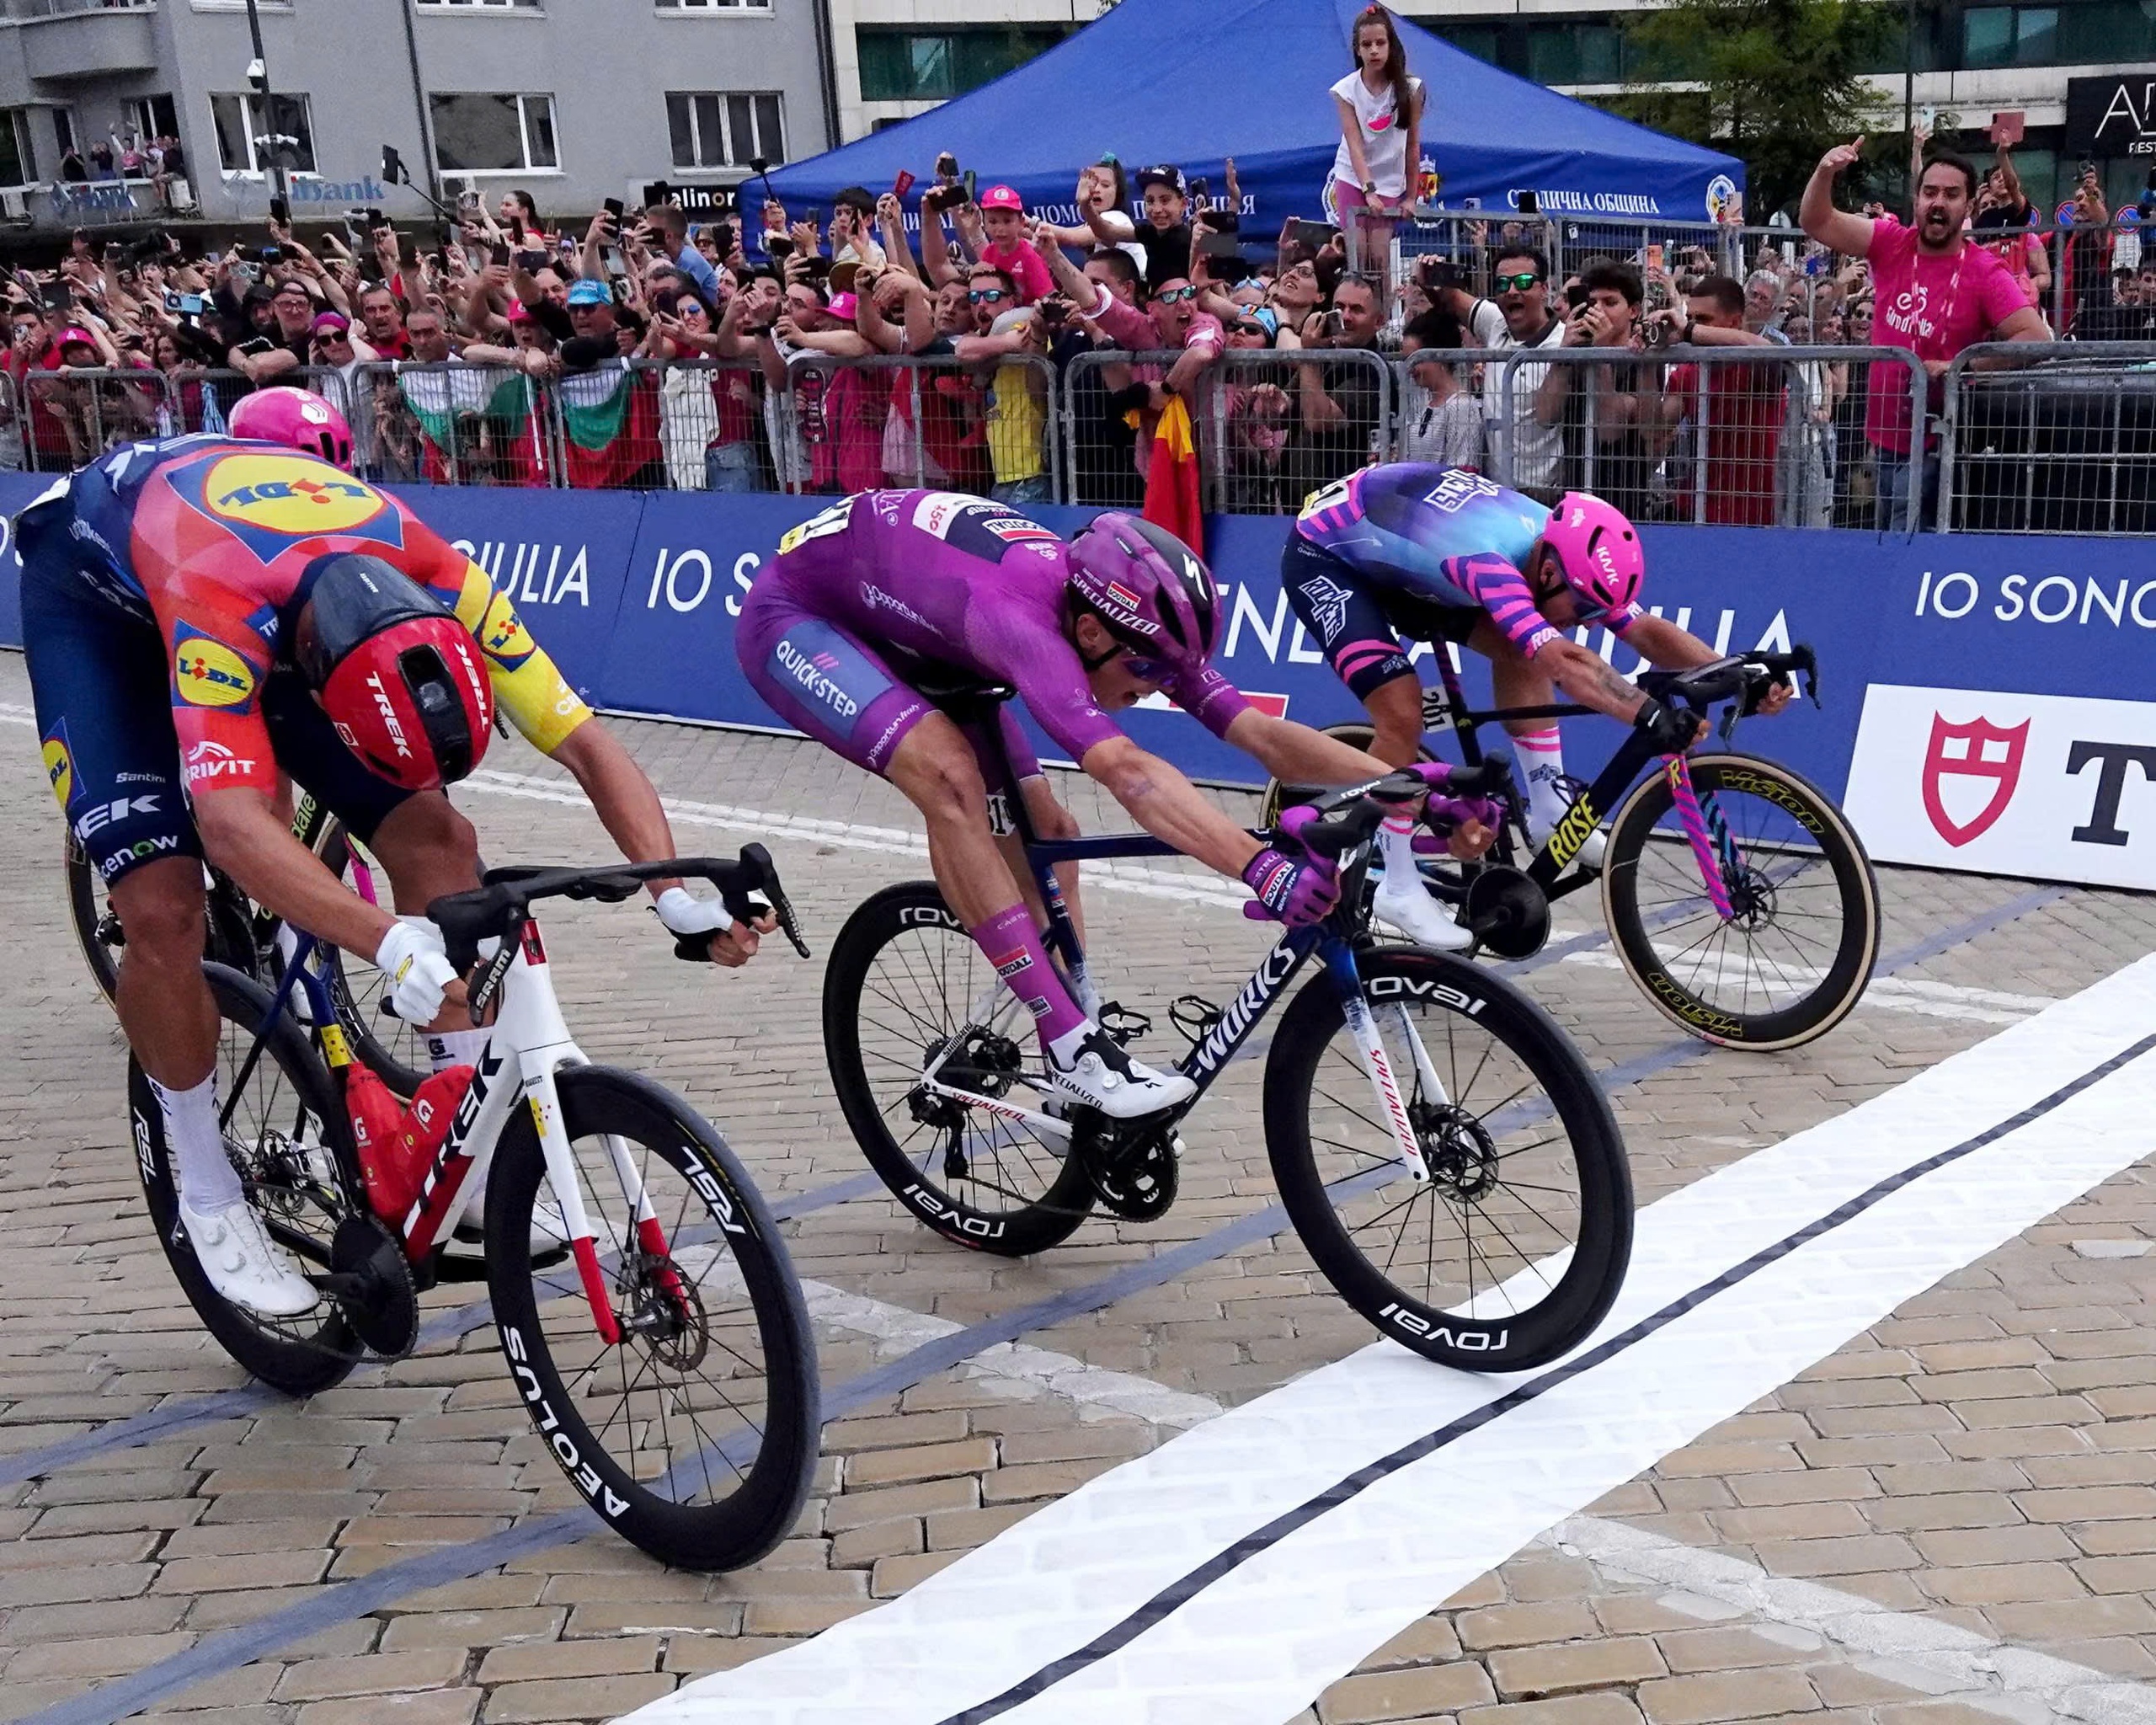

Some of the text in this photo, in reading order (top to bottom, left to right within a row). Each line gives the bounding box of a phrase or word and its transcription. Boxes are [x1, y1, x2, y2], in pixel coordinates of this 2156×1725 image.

[291, 174, 385, 200] ibank
[1507, 189, 1660, 215] СЛИЧНА ОБЩИНА
[648, 548, 712, 614] IO
[1070, 572, 1161, 636] SPECIALIZED
[1108, 588, 1137, 611] SOUDAL
[1915, 571, 1979, 618] IO
[1531, 627, 1564, 651] ROS
[454, 643, 490, 732] TREK
[1422, 692, 1446, 731] 201
[366, 670, 413, 759] TREK
[1548, 793, 1602, 868] ROSE
[1265, 862, 1294, 906] SOUDAL
[899, 907, 962, 927] rov
[477, 948, 511, 1008] SRAM
[999, 956, 1033, 976] OUDAL
[1194, 943, 1296, 1078] -WORKS
[1363, 976, 1487, 1015] oval
[942, 1021, 974, 1058] SHIMANO
[953, 1092, 1027, 1121] SPECIALIZED
[133, 1106, 158, 1186] RSL
[681, 1146, 747, 1235] RSL
[903, 1183, 1006, 1237] roval
[1379, 1302, 1508, 1351] roval
[504, 1325, 631, 1518] AEOLUS
